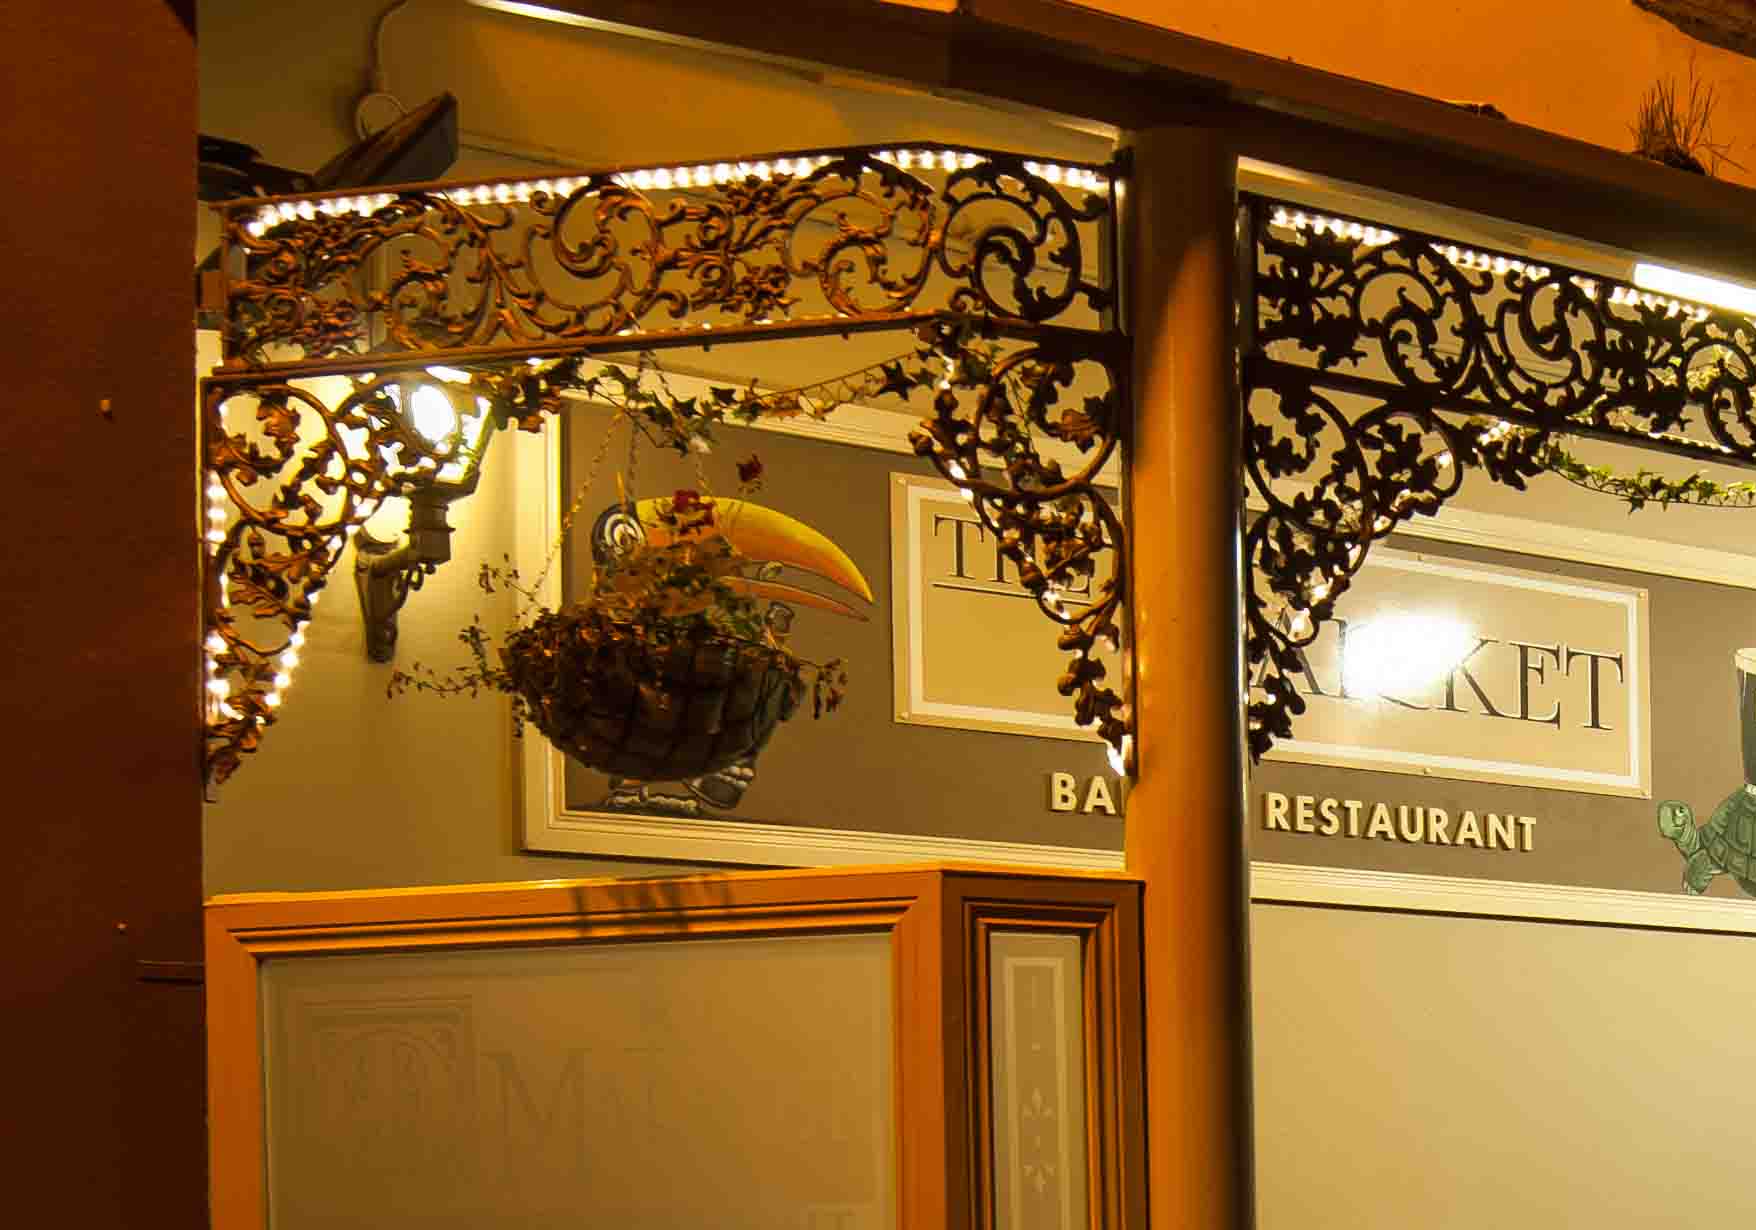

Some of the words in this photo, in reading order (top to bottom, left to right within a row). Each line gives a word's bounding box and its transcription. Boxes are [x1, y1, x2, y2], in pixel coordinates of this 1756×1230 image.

[1250, 606, 1625, 733] AKET
[1048, 771, 1125, 815] BA
[1264, 791, 1536, 851] RESTAURANT
